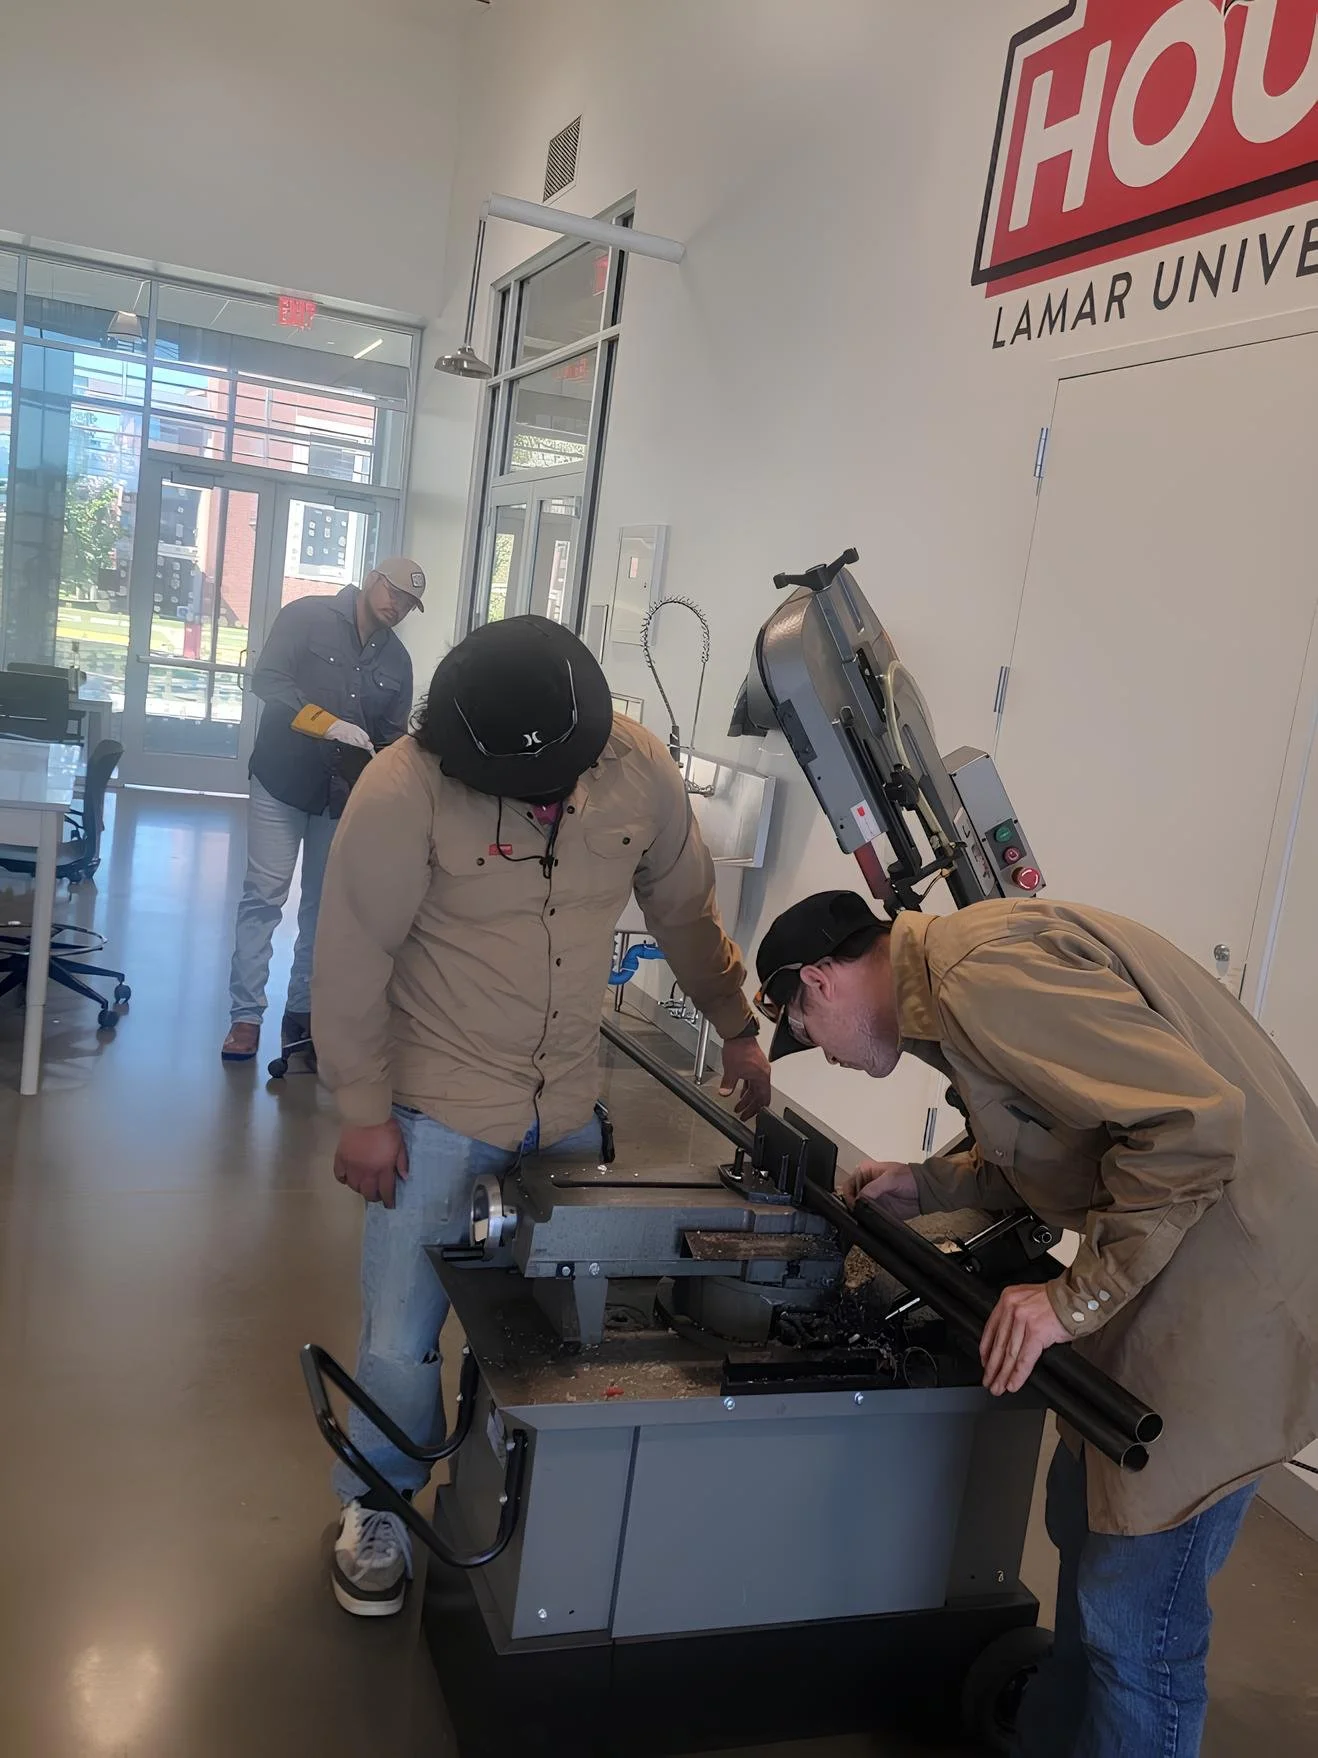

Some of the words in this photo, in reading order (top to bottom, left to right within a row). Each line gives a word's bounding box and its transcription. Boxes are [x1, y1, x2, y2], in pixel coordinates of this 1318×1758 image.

[1008, 0, 1318, 232] HOU
[992, 272, 1132, 349] LAMAR
[1153, 218, 1318, 310] UNIVE
